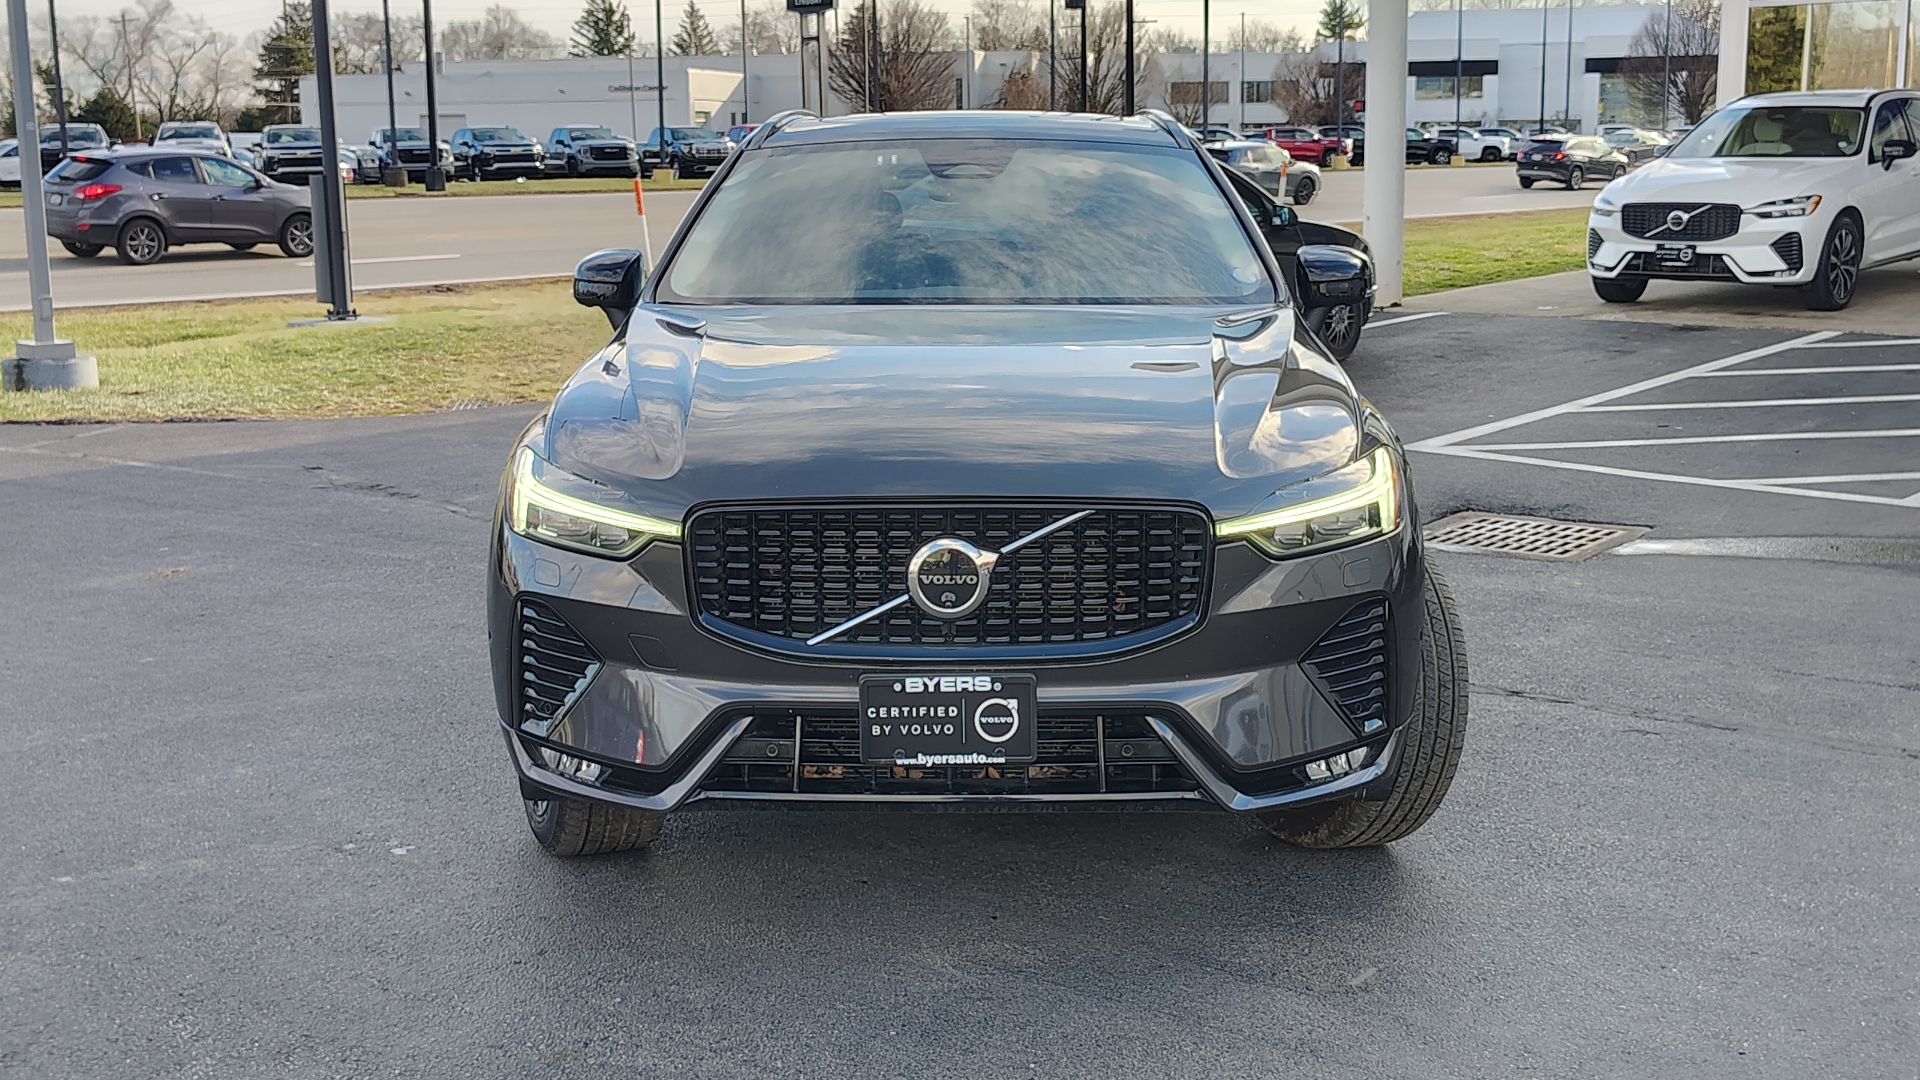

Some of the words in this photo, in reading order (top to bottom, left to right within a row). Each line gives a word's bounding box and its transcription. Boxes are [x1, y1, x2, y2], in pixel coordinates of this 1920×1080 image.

[919, 575, 978, 585] VOLVO
[904, 676, 992, 693] BYERS
[867, 706, 958, 718] CERTIFIED
[980, 716, 1013, 724] VOLVO
[871, 724, 891, 736] BY
[900, 724, 954, 736] VOLVO
[896, 752, 1006, 767] www.byersauto.com
